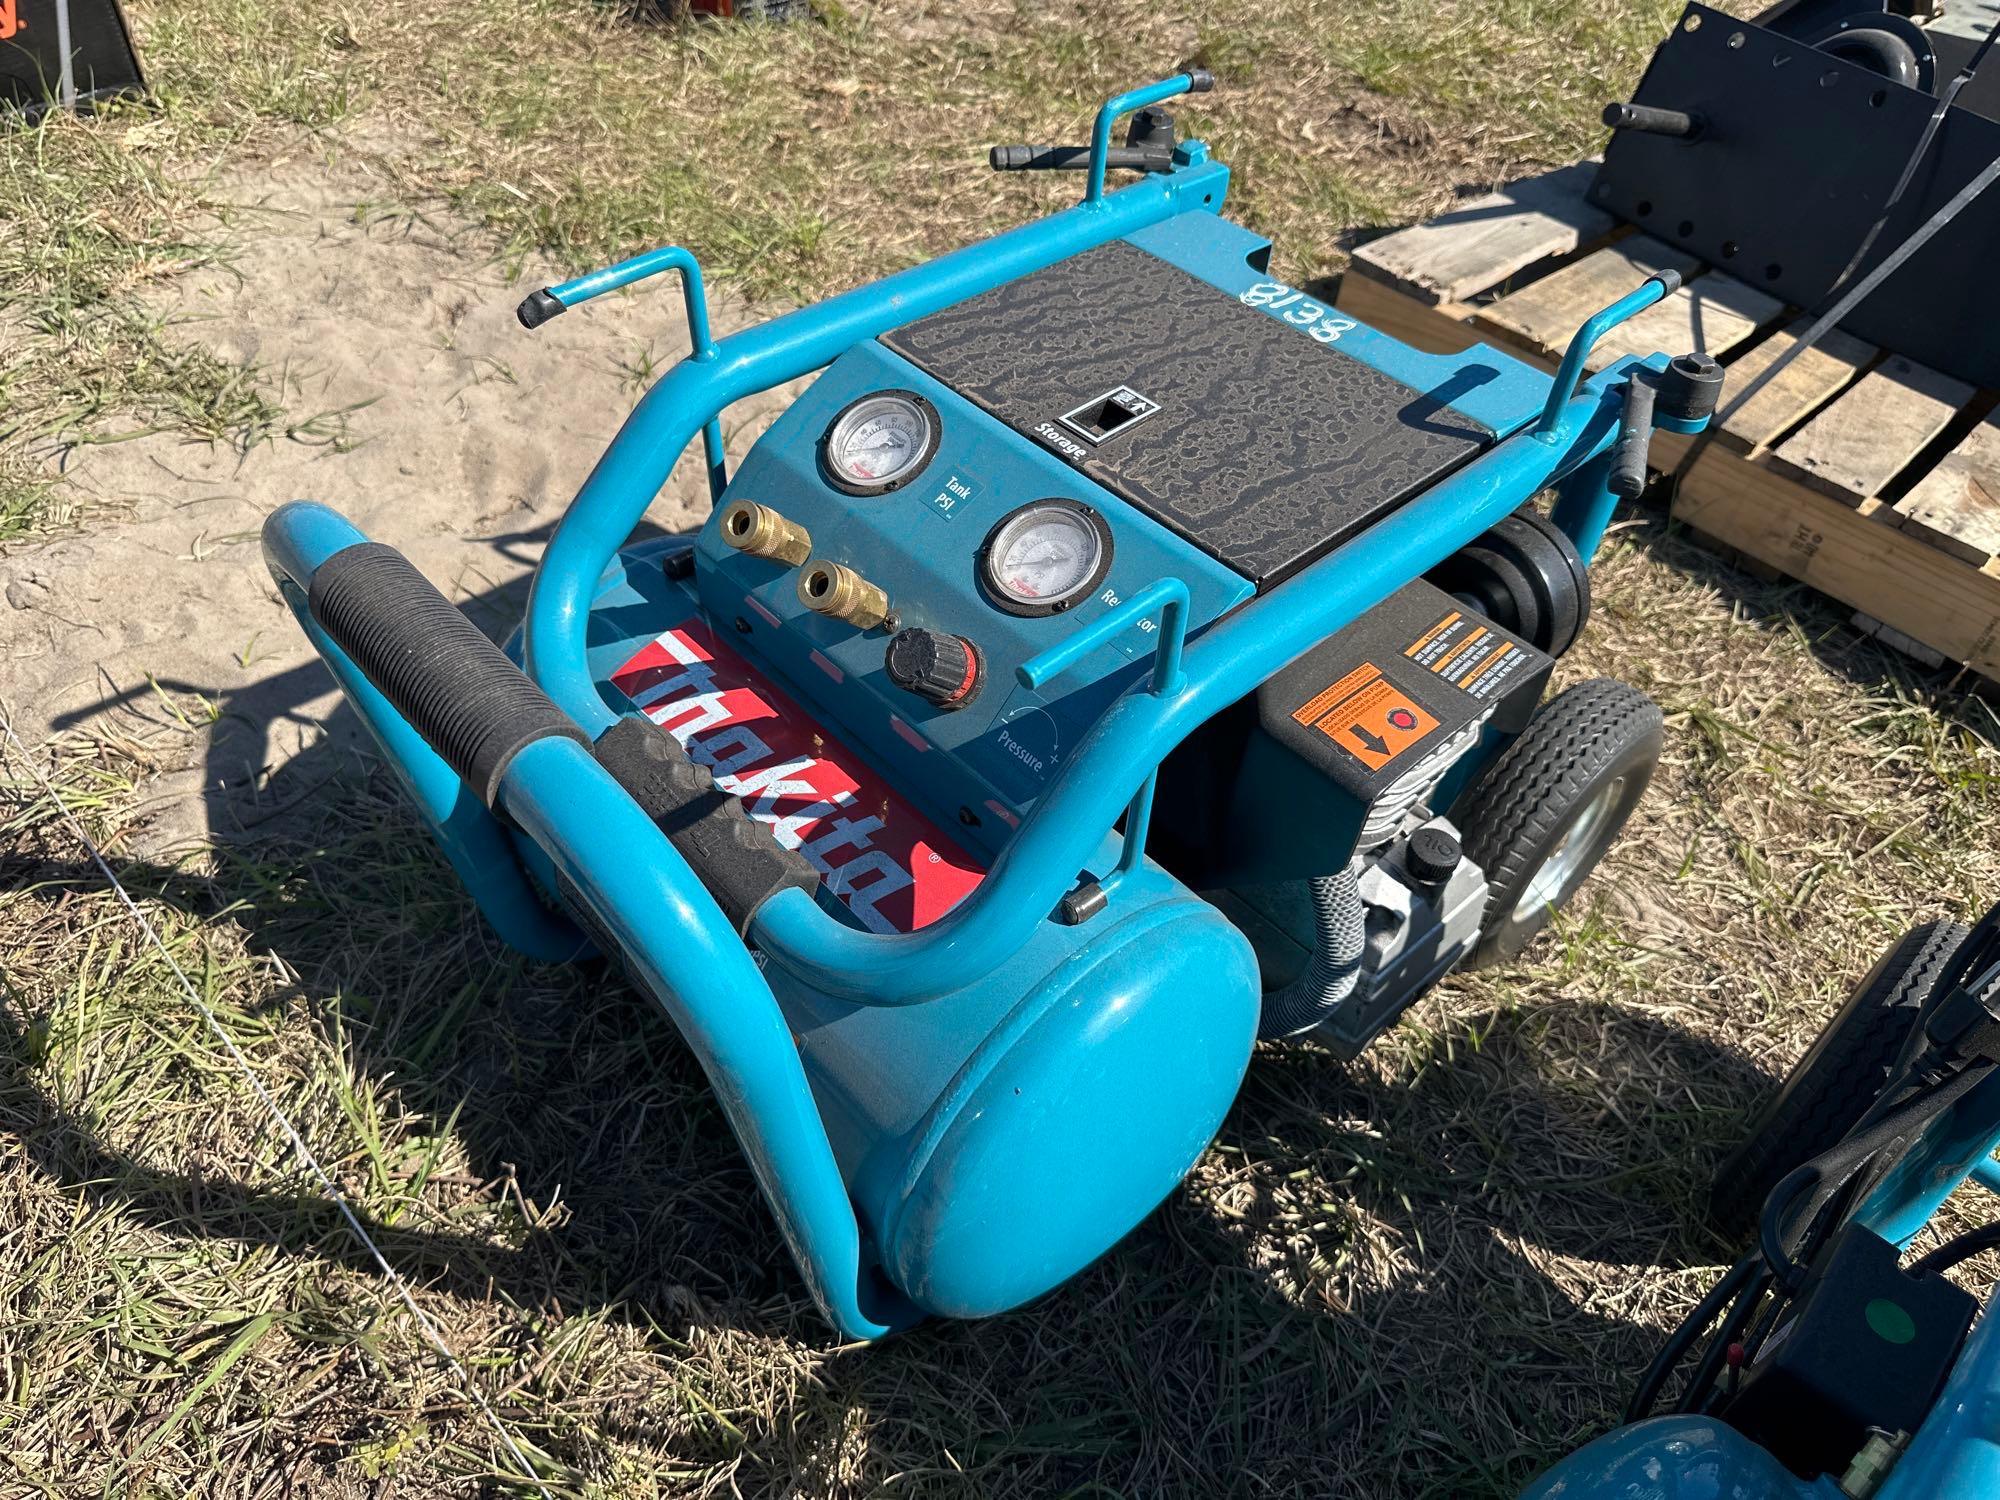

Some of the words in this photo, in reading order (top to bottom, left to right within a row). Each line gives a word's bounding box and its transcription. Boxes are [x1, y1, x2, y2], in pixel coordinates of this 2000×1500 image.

[1240, 282, 1357, 343] 8138
[1034, 423, 1087, 461] Storage
[934, 492, 956, 511] PSI
[945, 475, 971, 500] Tank
[1294, 696, 1324, 718] OVERLOAD
[1322, 676, 1354, 699] PROTECTION
[1352, 664, 1371, 678] SWITCH
[1318, 709, 1345, 729] LOCATED
[1343, 696, 1364, 711] BELOW
[1369, 680, 1385, 693] PUMP
[997, 729, 1043, 773] Pressure
